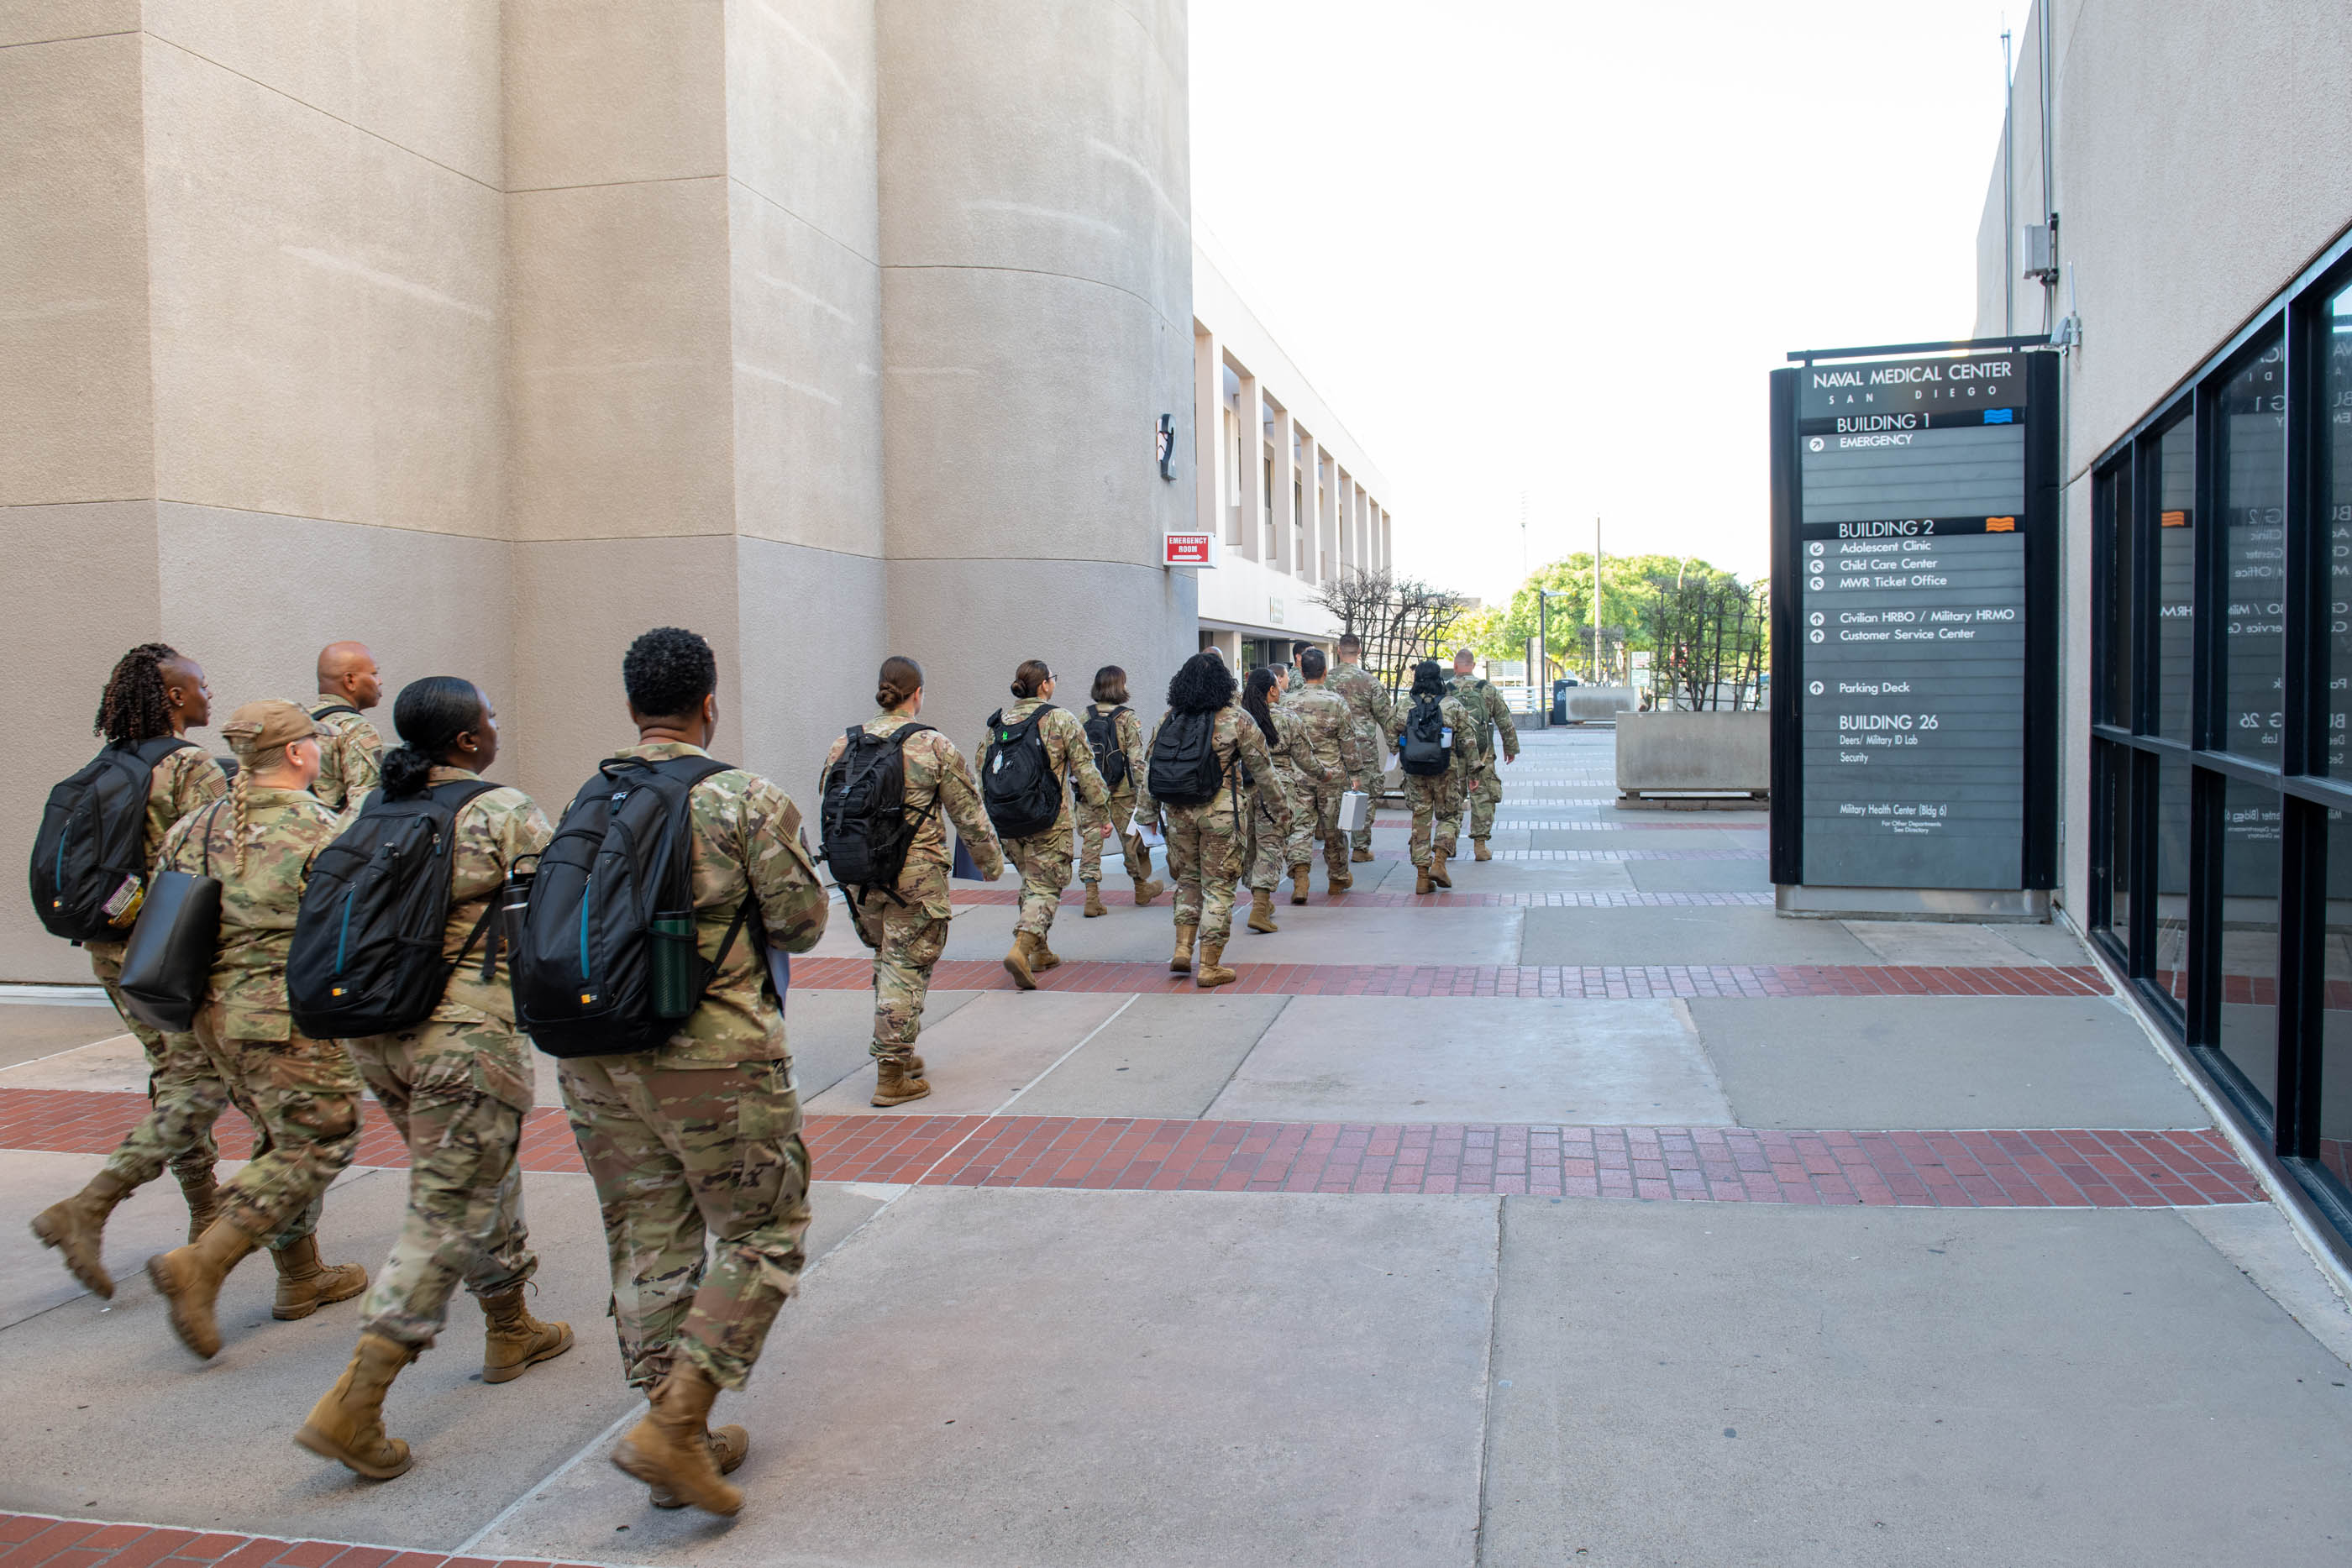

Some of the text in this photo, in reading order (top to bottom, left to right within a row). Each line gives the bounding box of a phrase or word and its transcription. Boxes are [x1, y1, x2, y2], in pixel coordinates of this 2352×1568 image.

[1814, 362, 2012, 388] NAVAL MEDICAL CENTER
[1829, 385, 1997, 405] SAN DIEGO
[1837, 413, 1929, 433] BUILDING 1
[1840, 433, 1913, 448] EMERGENCY
[1839, 520, 1934, 538] BUILDING 2
[1840, 540, 1931, 554] Adolescent Clinic
[1840, 558, 1938, 571] Child Care Center
[1840, 574, 1947, 588] MWR Ticket Office
[1840, 609, 2014, 623] Civilian HRBO / Military HRMO
[1840, 628, 1975, 641] Customer Service Center
[1839, 682, 1910, 695] Parking Deck
[1839, 714, 1939, 730] BUILDING 26
[1839, 734, 1918, 747] Deers/ Military ID Lab
[1840, 753, 1868, 764] Security
[1840, 804, 1947, 817] Military Health Center (Bldg 6)
